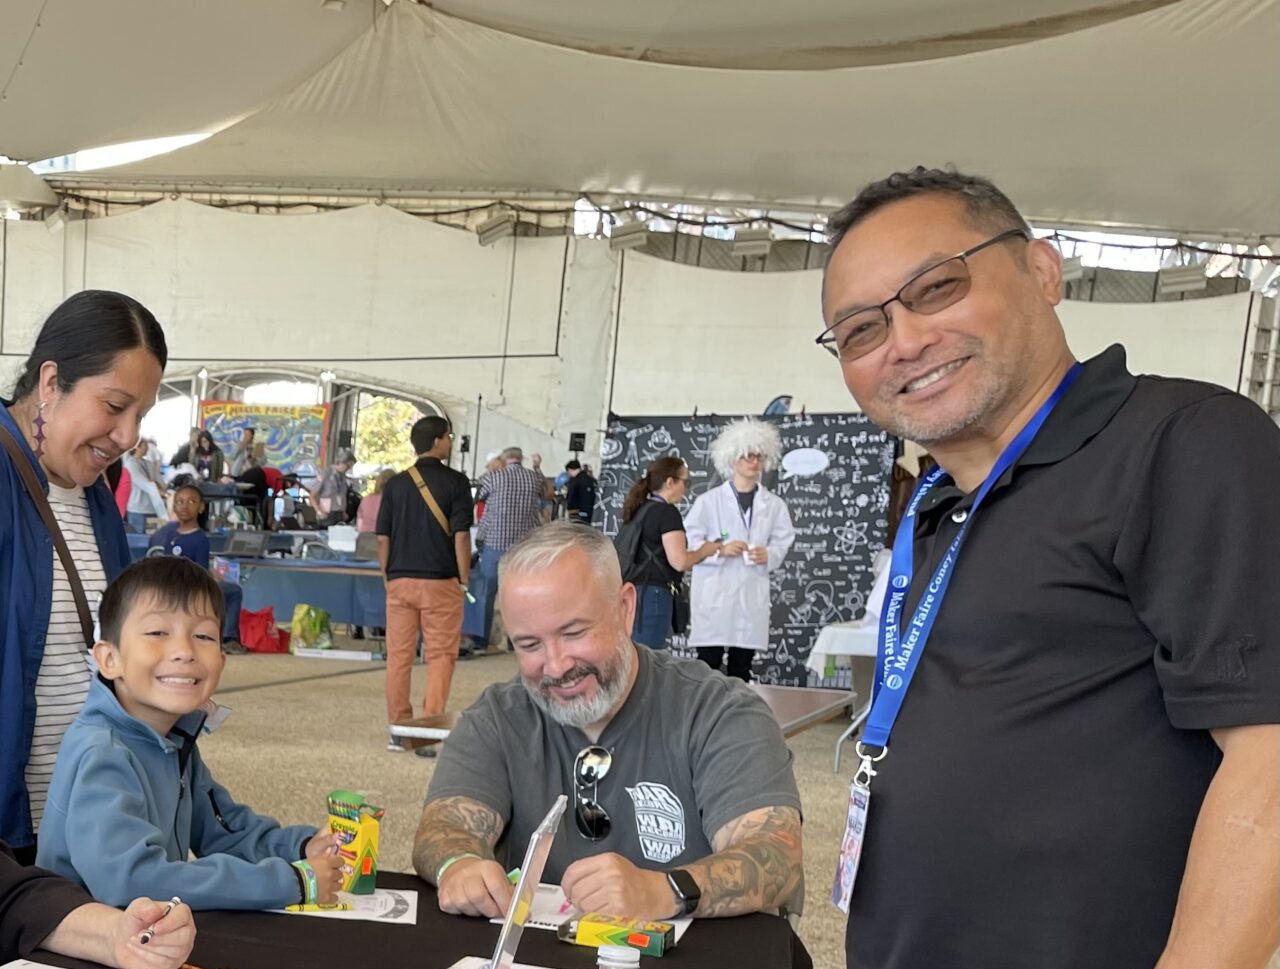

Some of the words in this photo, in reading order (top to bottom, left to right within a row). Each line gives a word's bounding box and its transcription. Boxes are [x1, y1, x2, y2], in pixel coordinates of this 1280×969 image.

[886, 592, 905, 625] Maker
[894, 628, 921, 672] Maker
[913, 592, 935, 628] Faire
[929, 553, 954, 593] Coney
[884, 624, 898, 656] Faire
